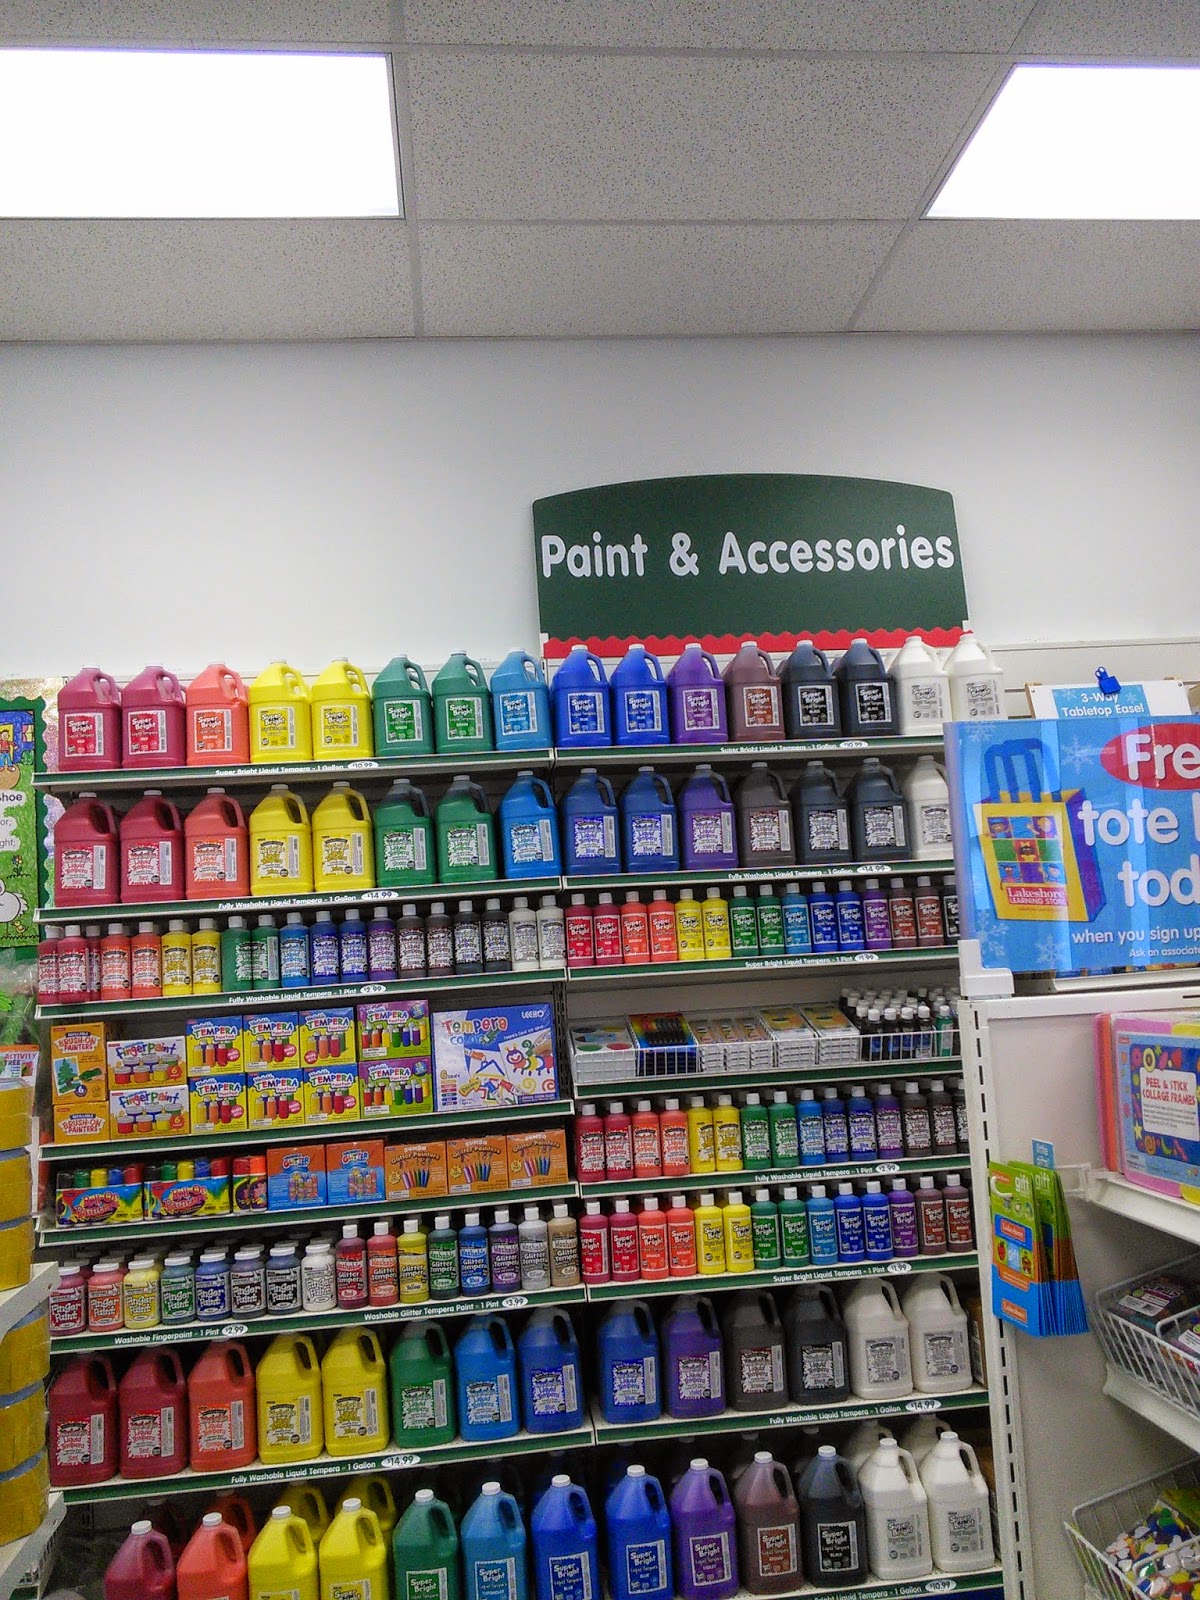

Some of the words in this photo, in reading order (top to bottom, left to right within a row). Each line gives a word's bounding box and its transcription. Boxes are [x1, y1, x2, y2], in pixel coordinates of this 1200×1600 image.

[541, 532, 648, 578] Paint
[669, 532, 699, 576] &
[718, 525, 955, 575] Accessories
[1061, 703, 1113, 717] Tabletop
[1115, 702, 1145, 715] Easel
[1077, 799, 1179, 847] tote
[1008, 886, 1066, 899] Lakeshore
[218, 902, 234, 910] Fully
[235, 900, 269, 909] Washable
[270, 899, 291, 907] Liquid
[292, 898, 322, 906] Tempera
[367, 891, 392, 899] $14.99
[1072, 929, 1114, 943] when
[1118, 929, 1145, 945] you
[1149, 928, 1180, 944] sign
[1129, 948, 1143, 958] Ask
[245, 994, 279, 1002] Washable
[302, 991, 332, 999] Tempera
[368, 1010, 407, 1022] TEMPERA
[252, 1021, 293, 1035] TEMPERA
[308, 1016, 349, 1029] TEMPERA
[443, 1016, 508, 1035] Tempera
[194, 1024, 237, 1039] TEMPERA
[58, 1036, 96, 1047] BRUSH-ON
[371, 1067, 410, 1080] TEMPERA
[255, 1077, 298, 1091] TEMPERA
[311, 1073, 353, 1086] TEMPERA
[1145, 1077, 1161, 1089] PEEL
[1163, 1080, 1169, 1089] &
[1170, 1080, 1188, 1092] STICK
[198, 1080, 240, 1094] TEMPERA
[1142, 1088, 1170, 1102] COLLAGE
[1170, 1093, 1196, 1106] FRAMES
[62, 1118, 101, 1128] BRUSH-ON
[822, 1169, 850, 1177] Tempera
[1015, 1175, 1030, 1192] gift
[1035, 1172, 1050, 1190] gift
[524, 1252, 546, 1260] Glitter
[556, 1249, 578, 1258] Glitter
[430, 1260, 454, 1269] Glitter
[462, 1258, 485, 1266] Glitter
[773, 1275, 792, 1283] Super
[793, 1273, 813, 1281] Bright
[813, 1271, 833, 1279] Liquid
[834, 1269, 862, 1277] Tempera
[268, 1284, 297, 1295] Finger
[163, 1291, 192, 1302] Finger
[271, 1292, 295, 1302] Paint
[51, 1302, 82, 1314] Finger
[91, 1298, 119, 1310] Finger
[167, 1299, 190, 1310] Paint
[54, 1312, 77, 1322] Paint
[93, 1307, 116, 1318] Paint
[364, 1311, 399, 1320] Washable
[400, 1309, 423, 1317] Glitter
[424, 1306, 454, 1316] Tempera
[456, 1304, 474, 1312] Paint
[114, 1334, 151, 1344] Washable
[152, 1331, 193, 1342] Fingerpaint
[205, 1328, 219, 1336] Pint
[224, 1325, 244, 1335] $2.99
[769, 1417, 785, 1425] Fully
[785, 1415, 818, 1423] Washable
[819, 1412, 839, 1420] Liquid
[840, 1409, 869, 1418] Tempera
[910, 1401, 935, 1410] $14.99
[231, 1475, 247, 1483] Fully
[249, 1472, 284, 1481] Washable
[285, 1469, 307, 1478] Liquid
[309, 1466, 341, 1475] Tempera
[352, 1461, 376, 1469] Gallon
[387, 1456, 414, 1466] $14.99
[762, 1533, 784, 1543] Super
[821, 1531, 844, 1539] Super
[825, 1536, 847, 1545] Bright
[694, 1543, 716, 1552] Super
[766, 1538, 788, 1549] Bright
[630, 1551, 652, 1560] Super
[698, 1548, 720, 1558] Bright
[634, 1556, 656, 1566] Bright
[479, 1567, 501, 1577] Super
[553, 1564, 576, 1574] Super
[556, 1569, 579, 1580] Bright
[410, 1578, 432, 1587] Super
[483, 1573, 505, 1583] Bright
[414, 1583, 437, 1593] Bright
[858, 1590, 888, 1600] Tempera
[900, 1586, 922, 1594] Gallon
